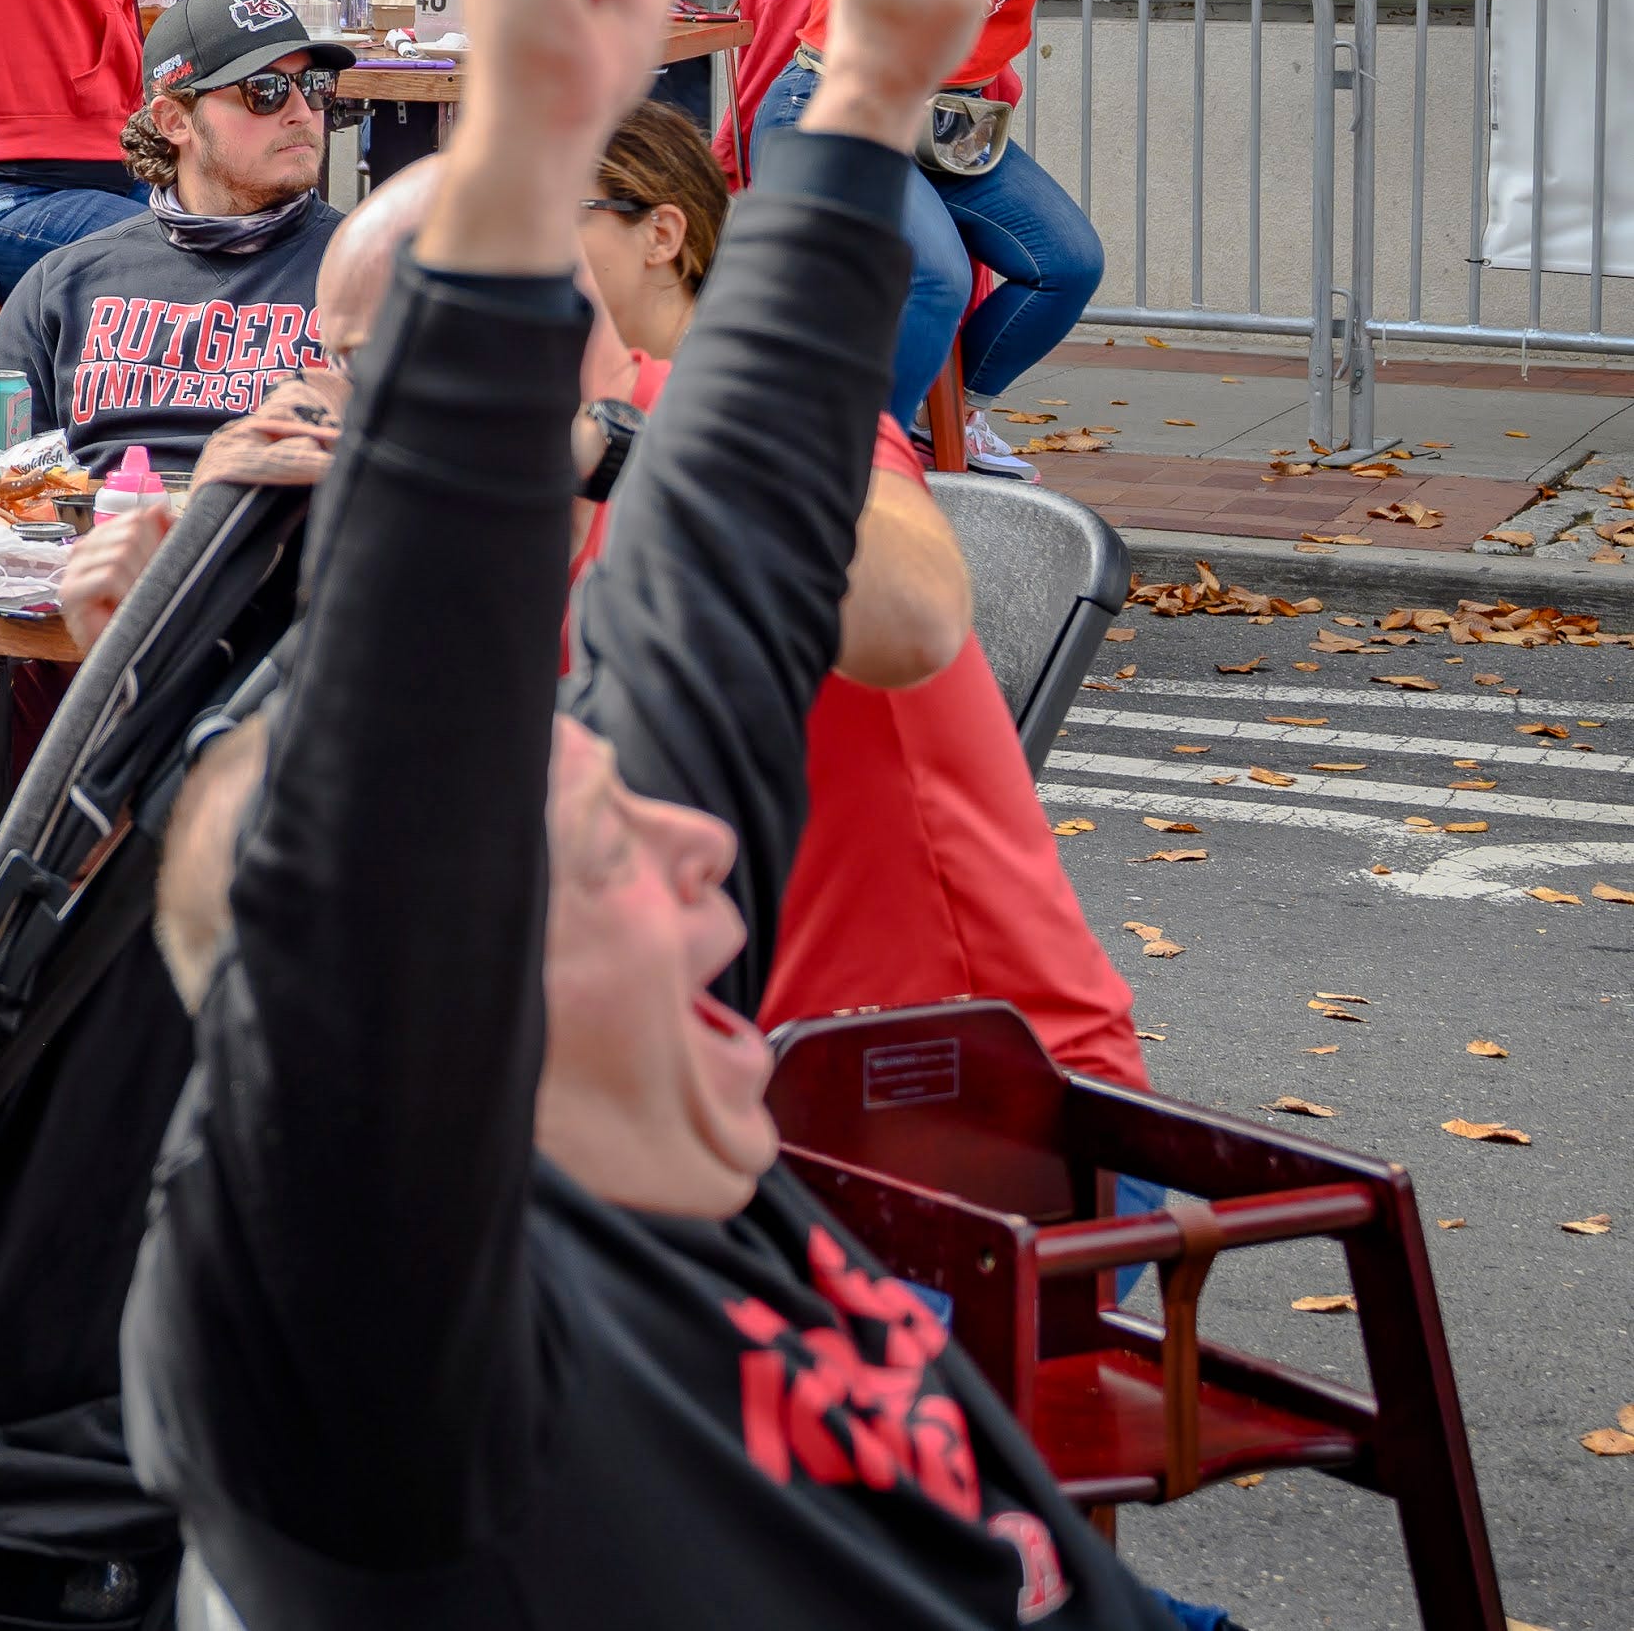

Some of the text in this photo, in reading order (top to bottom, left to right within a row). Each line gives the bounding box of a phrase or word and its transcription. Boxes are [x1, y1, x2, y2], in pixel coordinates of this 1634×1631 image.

[81, 296, 332, 373] RUTGERS
[71, 361, 297, 425] UNIVERSI
[19, 451, 64, 475] oldfish
